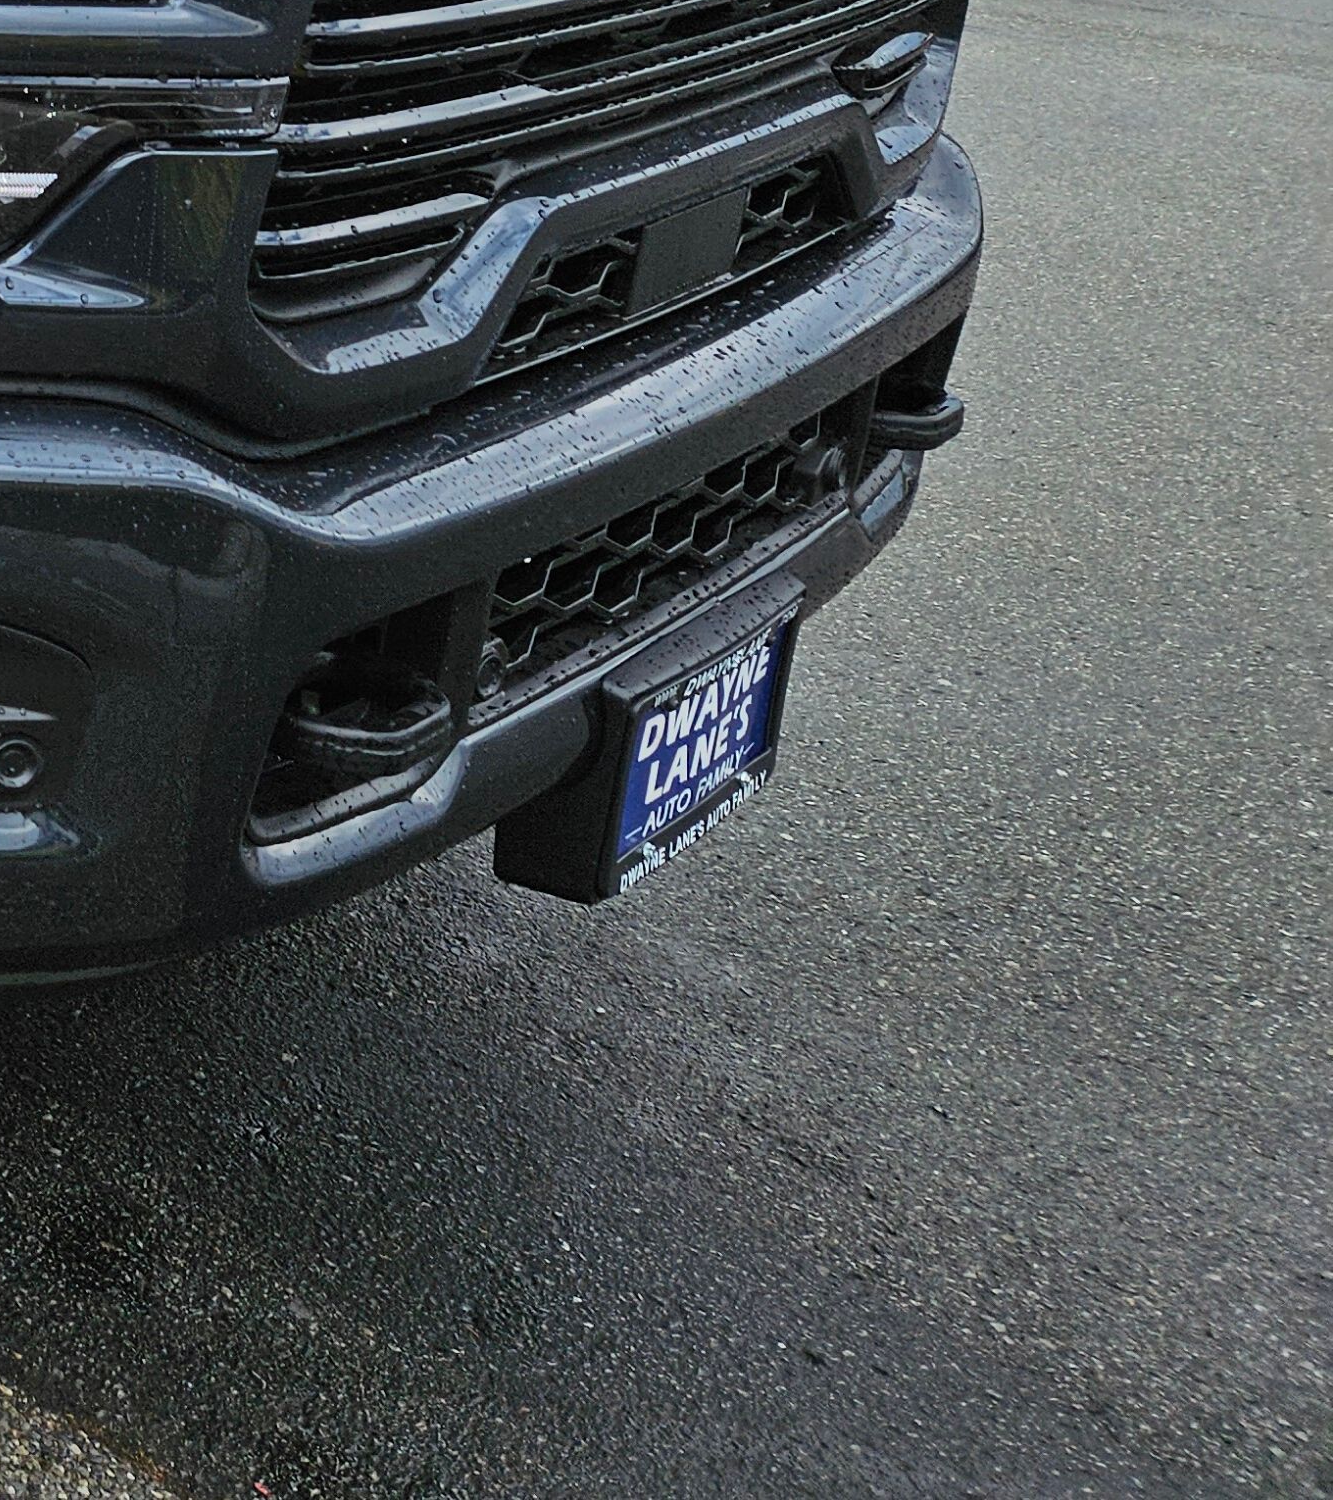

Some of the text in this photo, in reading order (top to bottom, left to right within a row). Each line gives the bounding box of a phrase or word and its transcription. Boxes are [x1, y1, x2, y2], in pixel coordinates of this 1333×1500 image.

[637, 645, 770, 763] DWAYNE
[644, 693, 753, 805] LANE'S
[619, 845, 667, 894] DWAYNE
[706, 798, 731, 832] AUTO
[641, 787, 693, 838] AUTO
